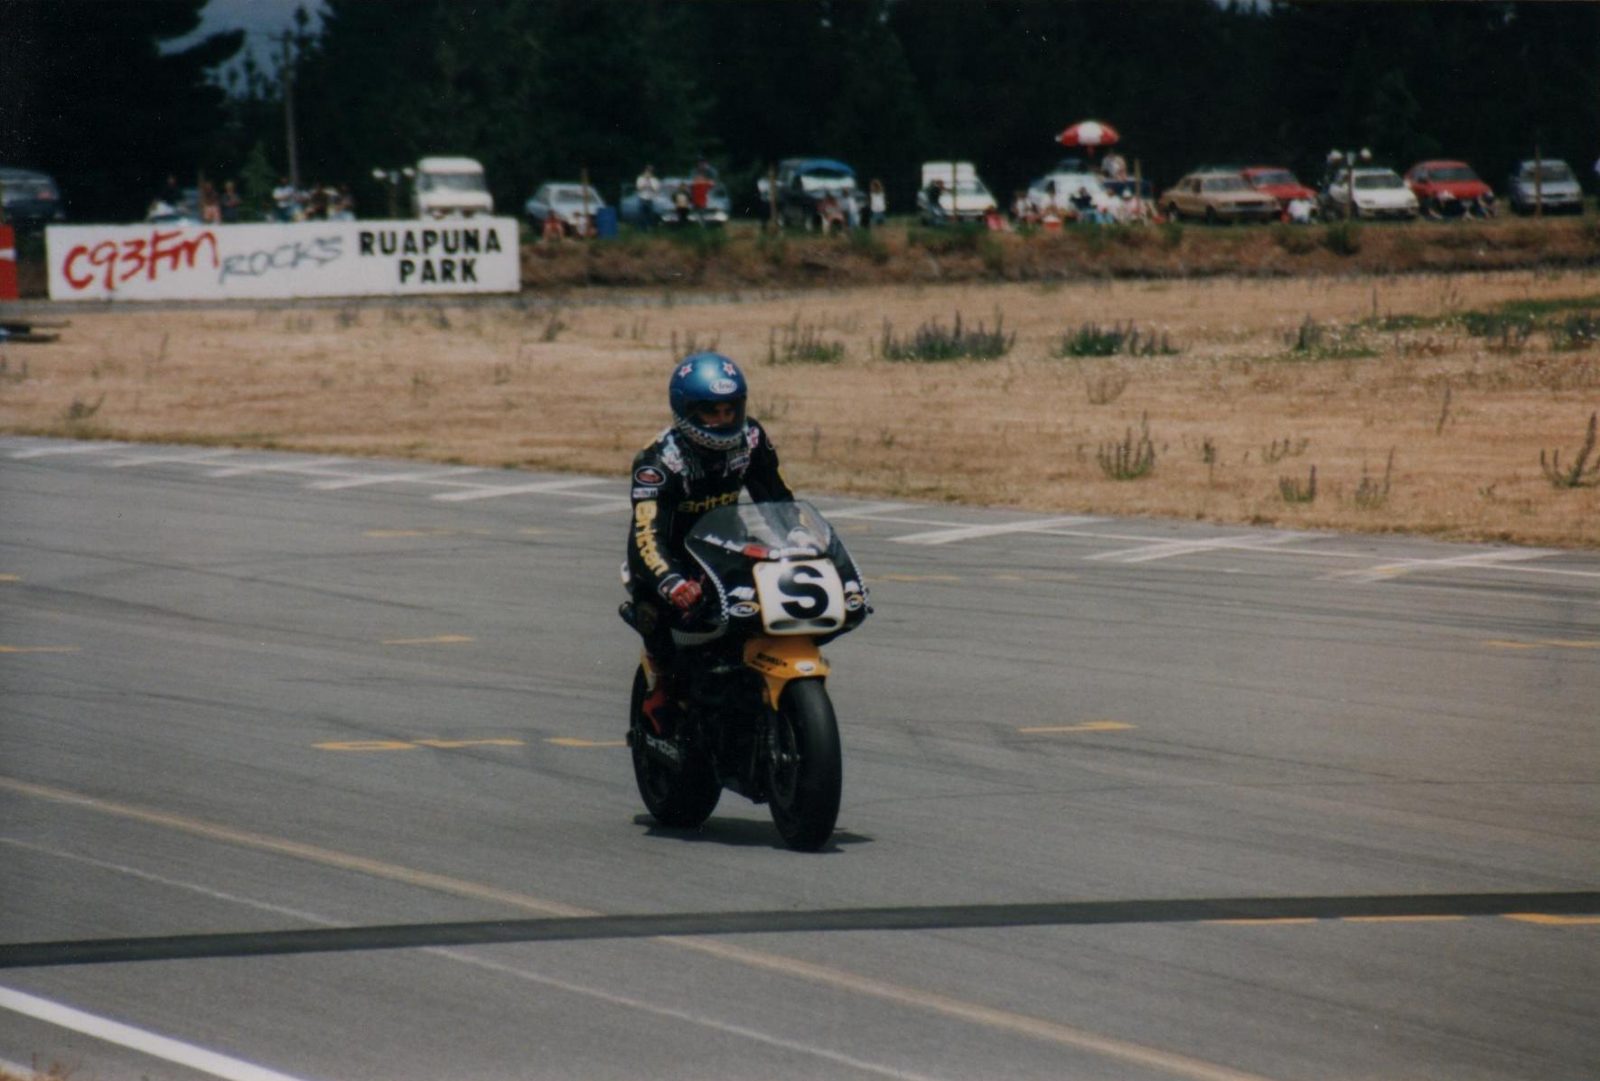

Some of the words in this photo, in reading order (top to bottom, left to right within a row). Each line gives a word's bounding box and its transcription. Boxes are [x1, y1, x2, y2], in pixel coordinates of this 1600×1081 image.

[219, 235, 343, 284] ROCKS
[359, 228, 502, 255] RUAPUNA
[400, 259, 477, 284] PARK
[778, 565, 829, 619] S
